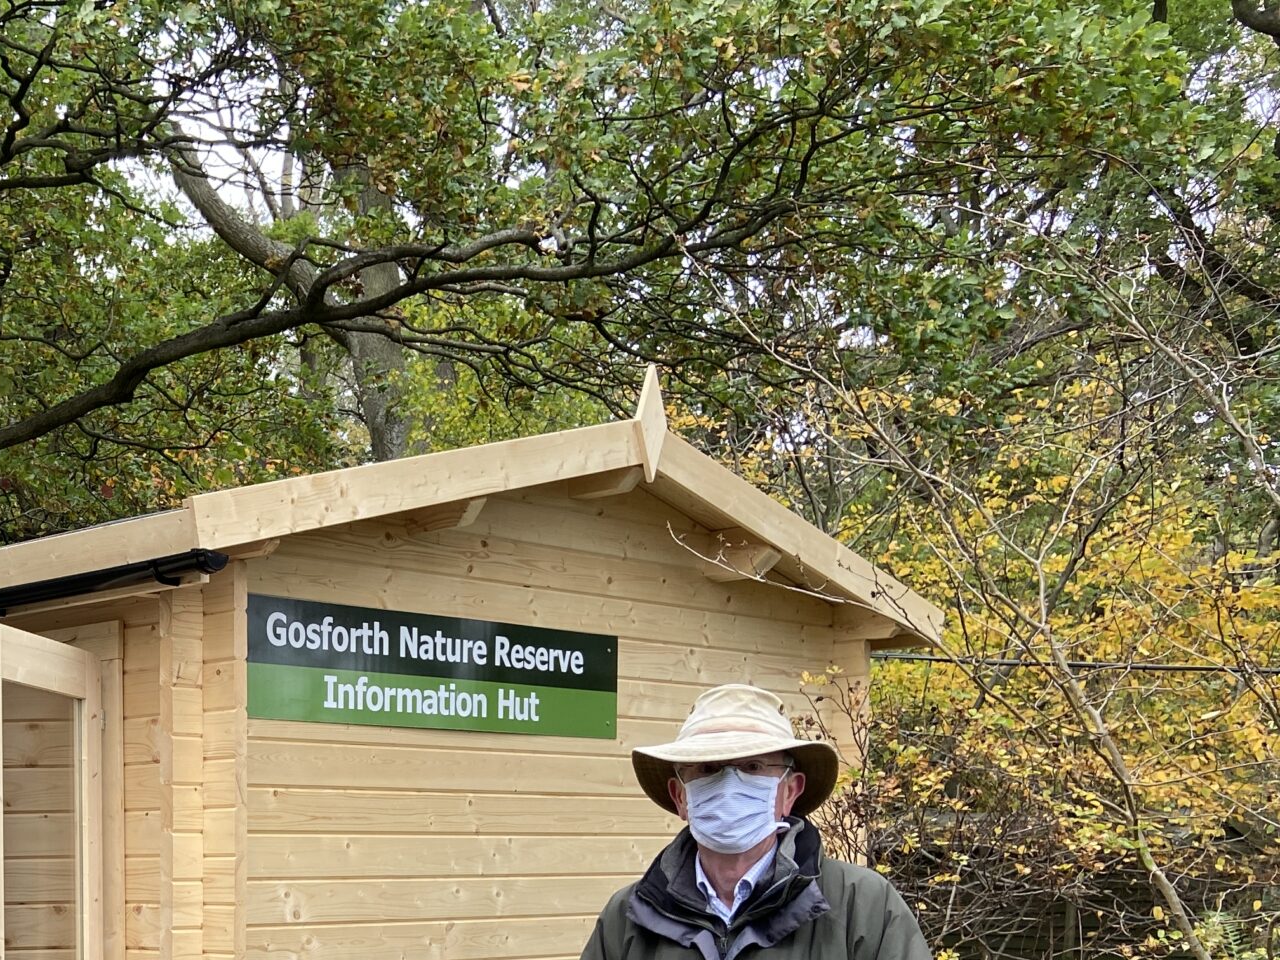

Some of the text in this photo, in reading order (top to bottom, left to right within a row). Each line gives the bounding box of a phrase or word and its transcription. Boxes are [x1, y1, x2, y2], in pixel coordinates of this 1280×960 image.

[266, 611, 585, 675] Gosforth Nature Reserve
[323, 675, 540, 722] Information Hut
